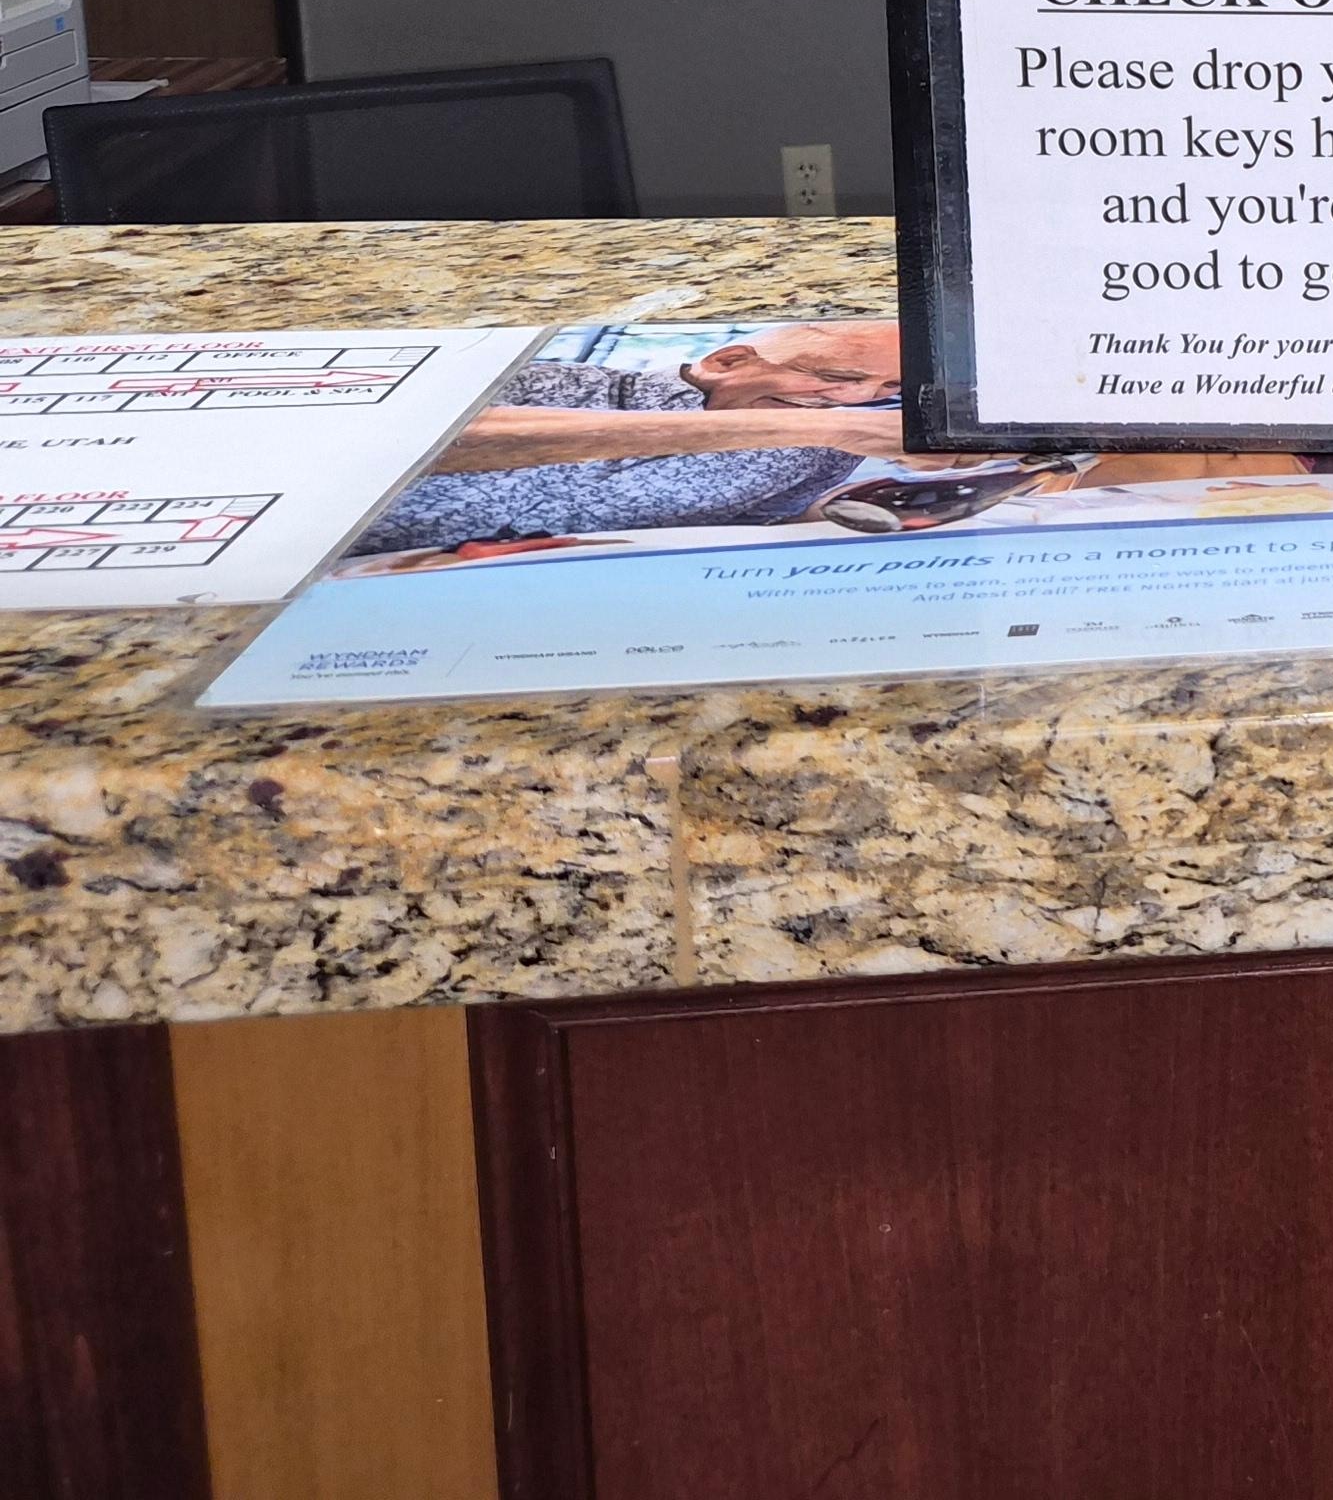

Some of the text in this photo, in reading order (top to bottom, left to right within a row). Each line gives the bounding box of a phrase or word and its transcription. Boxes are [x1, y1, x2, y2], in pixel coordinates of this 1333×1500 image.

[1016, 46, 1173, 89] Please
[1193, 48, 1302, 102] drop
[1036, 128, 1167, 156] room
[1183, 116, 1293, 169] keys
[1103, 182, 1190, 223] and
[1102, 249, 1222, 301] good
[1239, 255, 1283, 289] to
[73, 342, 264, 353] FIRST FLOOR
[1090, 333, 1170, 353] Thank
[1181, 334, 1223, 353] You
[1228, 333, 1269, 359] for
[1274, 340, 1333, 359] your
[212, 351, 303, 360] OFFICE
[227, 388, 297, 398] POOL
[328, 387, 375, 395] SPA
[1098, 375, 1162, 394] Have
[1171, 381, 1184, 394] a
[1197, 374, 1325, 400] Wonderful
[41, 436, 139, 449] UTAH
[14, 490, 130, 503] FLOOR
[31, 505, 76, 515] 220
[111, 502, 155, 512] 222
[171, 500, 214, 509] 224
[55, 548, 102, 557] 227
[130, 546, 177, 555] 229
[701, 566, 774, 580] Turn
[783, 562, 875, 580] your
[875, 554, 995, 575] points
[1006, 551, 1072, 565] into
[1084, 550, 1102, 561] a
[1115, 542, 1256, 560] moment
[1268, 540, 1298, 553] to
[746, 587, 795, 599] With
[803, 585, 858, 596] more
[864, 582, 918, 594] ways
[925, 580, 946, 589] to
[1015, 574, 1056, 585] and
[1061, 572, 1111, 583] even
[1117, 570, 1171, 580] more
[1176, 567, 1227, 579] ways
[1234, 564, 1255, 575] to
[911, 591, 955, 603] And
[961, 588, 1008, 601] best
[1014, 588, 1036, 598] of
[1041, 586, 1079, 597] all?
[1085, 584, 1133, 595] FREE
[1140, 580, 1217, 593] NIGHTS
[1221, 575, 1268, 587] start
[1276, 576, 1296, 586] at
[308, 648, 430, 662] WYNDHAM
[298, 657, 421, 672] REWARDS
